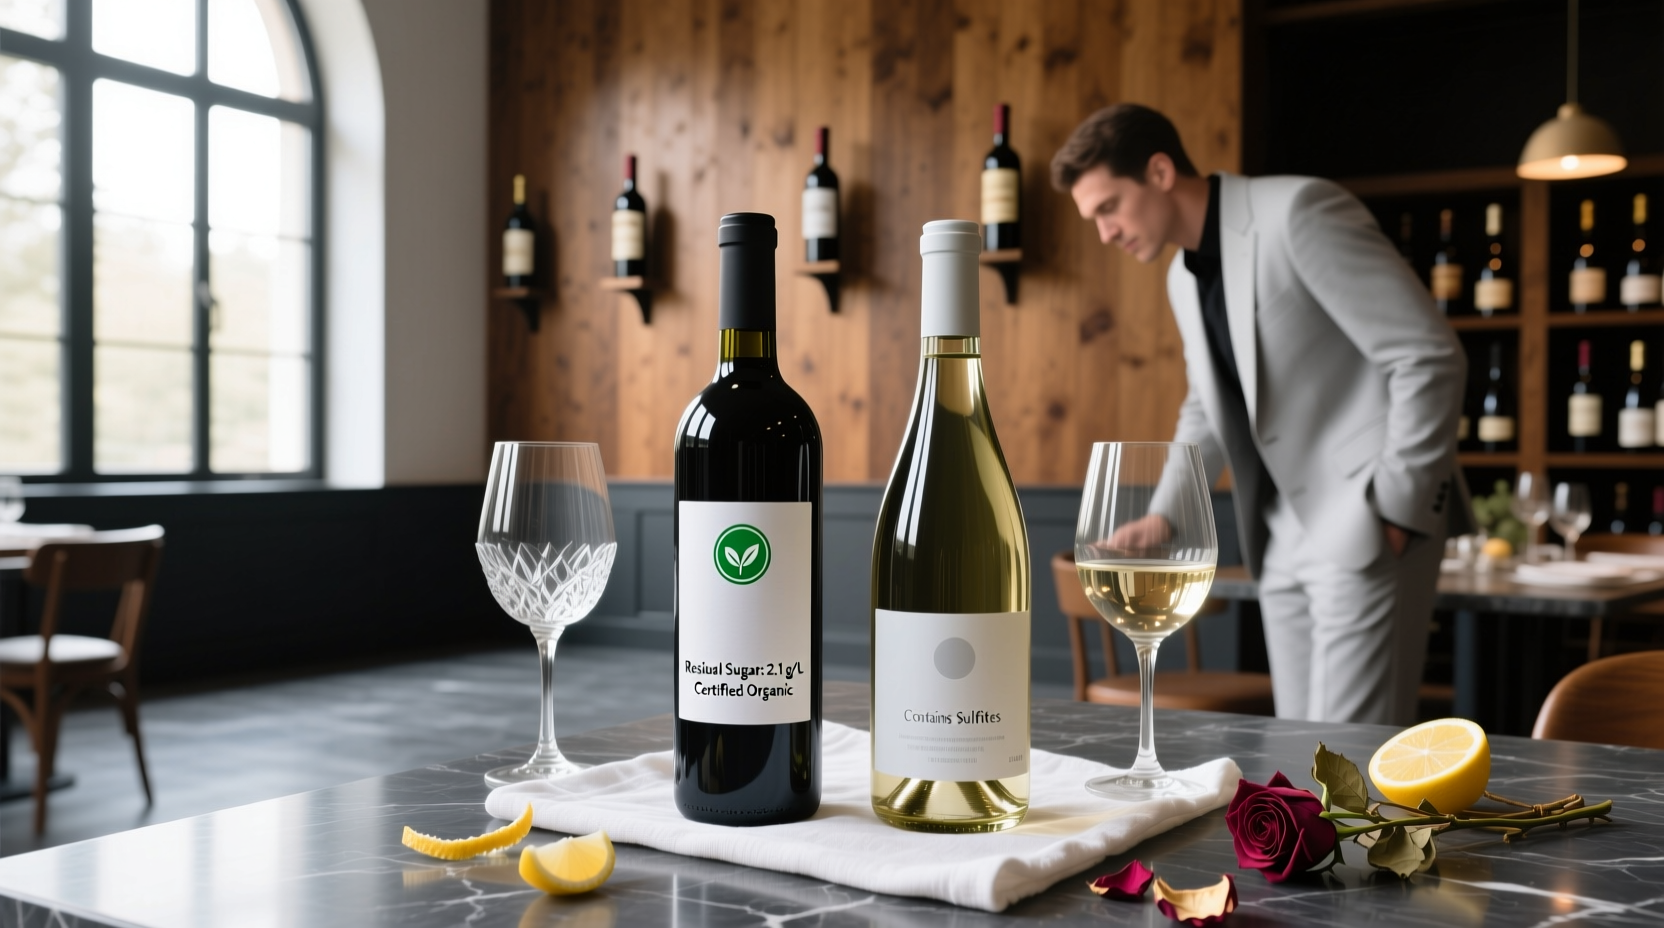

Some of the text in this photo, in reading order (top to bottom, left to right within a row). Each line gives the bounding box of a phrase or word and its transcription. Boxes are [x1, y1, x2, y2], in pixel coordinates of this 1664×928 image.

[725, 662, 764, 680] Sugar:
[694, 681, 793, 701] Certified Organic
[904, 709, 1001, 724] Contains Sulfites
